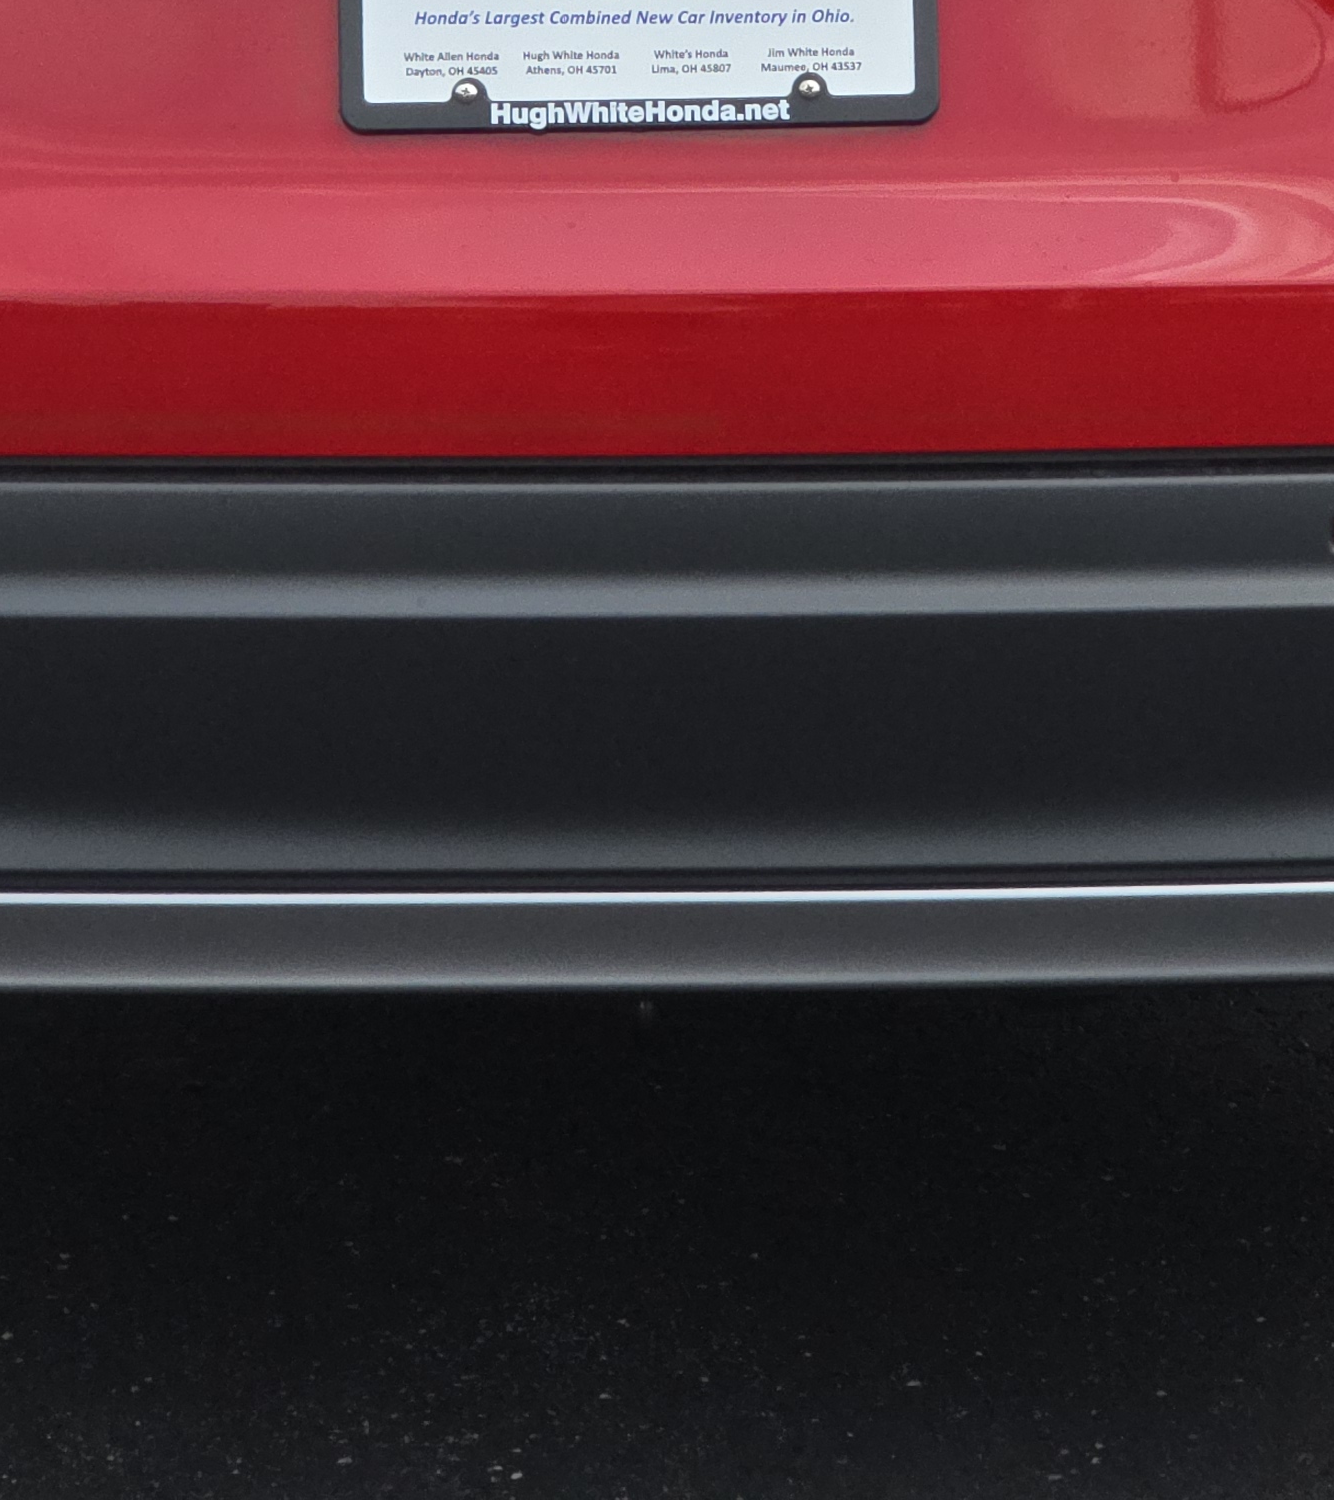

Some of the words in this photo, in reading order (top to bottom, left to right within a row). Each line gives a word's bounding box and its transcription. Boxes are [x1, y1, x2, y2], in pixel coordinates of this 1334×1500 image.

[414, 10, 480, 25] Honda's
[484, 11, 545, 28] Largest
[549, 9, 632, 25] Combined
[636, 10, 673, 25] New
[677, 9, 705, 24] Car
[709, 9, 788, 27] Inventory
[791, 8, 807, 24] in
[811, 8, 855, 23] Ohio.
[403, 52, 435, 62] White
[437, 51, 464, 62] Allen
[466, 51, 500, 61] Honda
[523, 50, 550, 61] Hugh
[552, 50, 584, 60] White
[586, 49, 620, 60] Honda
[654, 49, 693, 59] White's
[695, 48, 729, 59] Honda
[767, 48, 785, 58] Jim
[787, 47, 819, 58] White
[821, 47, 855, 57] Honda
[405, 66, 446, 78] Dayton,
[448, 66, 465, 76] OH
[466, 66, 498, 76] 45405
[526, 65, 565, 76] Athens,
[567, 64, 584, 75] OH
[585, 64, 617, 75] 45701
[651, 63, 679, 74] Lima,
[681, 63, 698, 73] OH
[700, 63, 732, 73] 45807
[812, 61, 829, 72] OH
[831, 61, 862, 71] 43537
[490, 99, 790, 129] HughWhiteHonda.net
